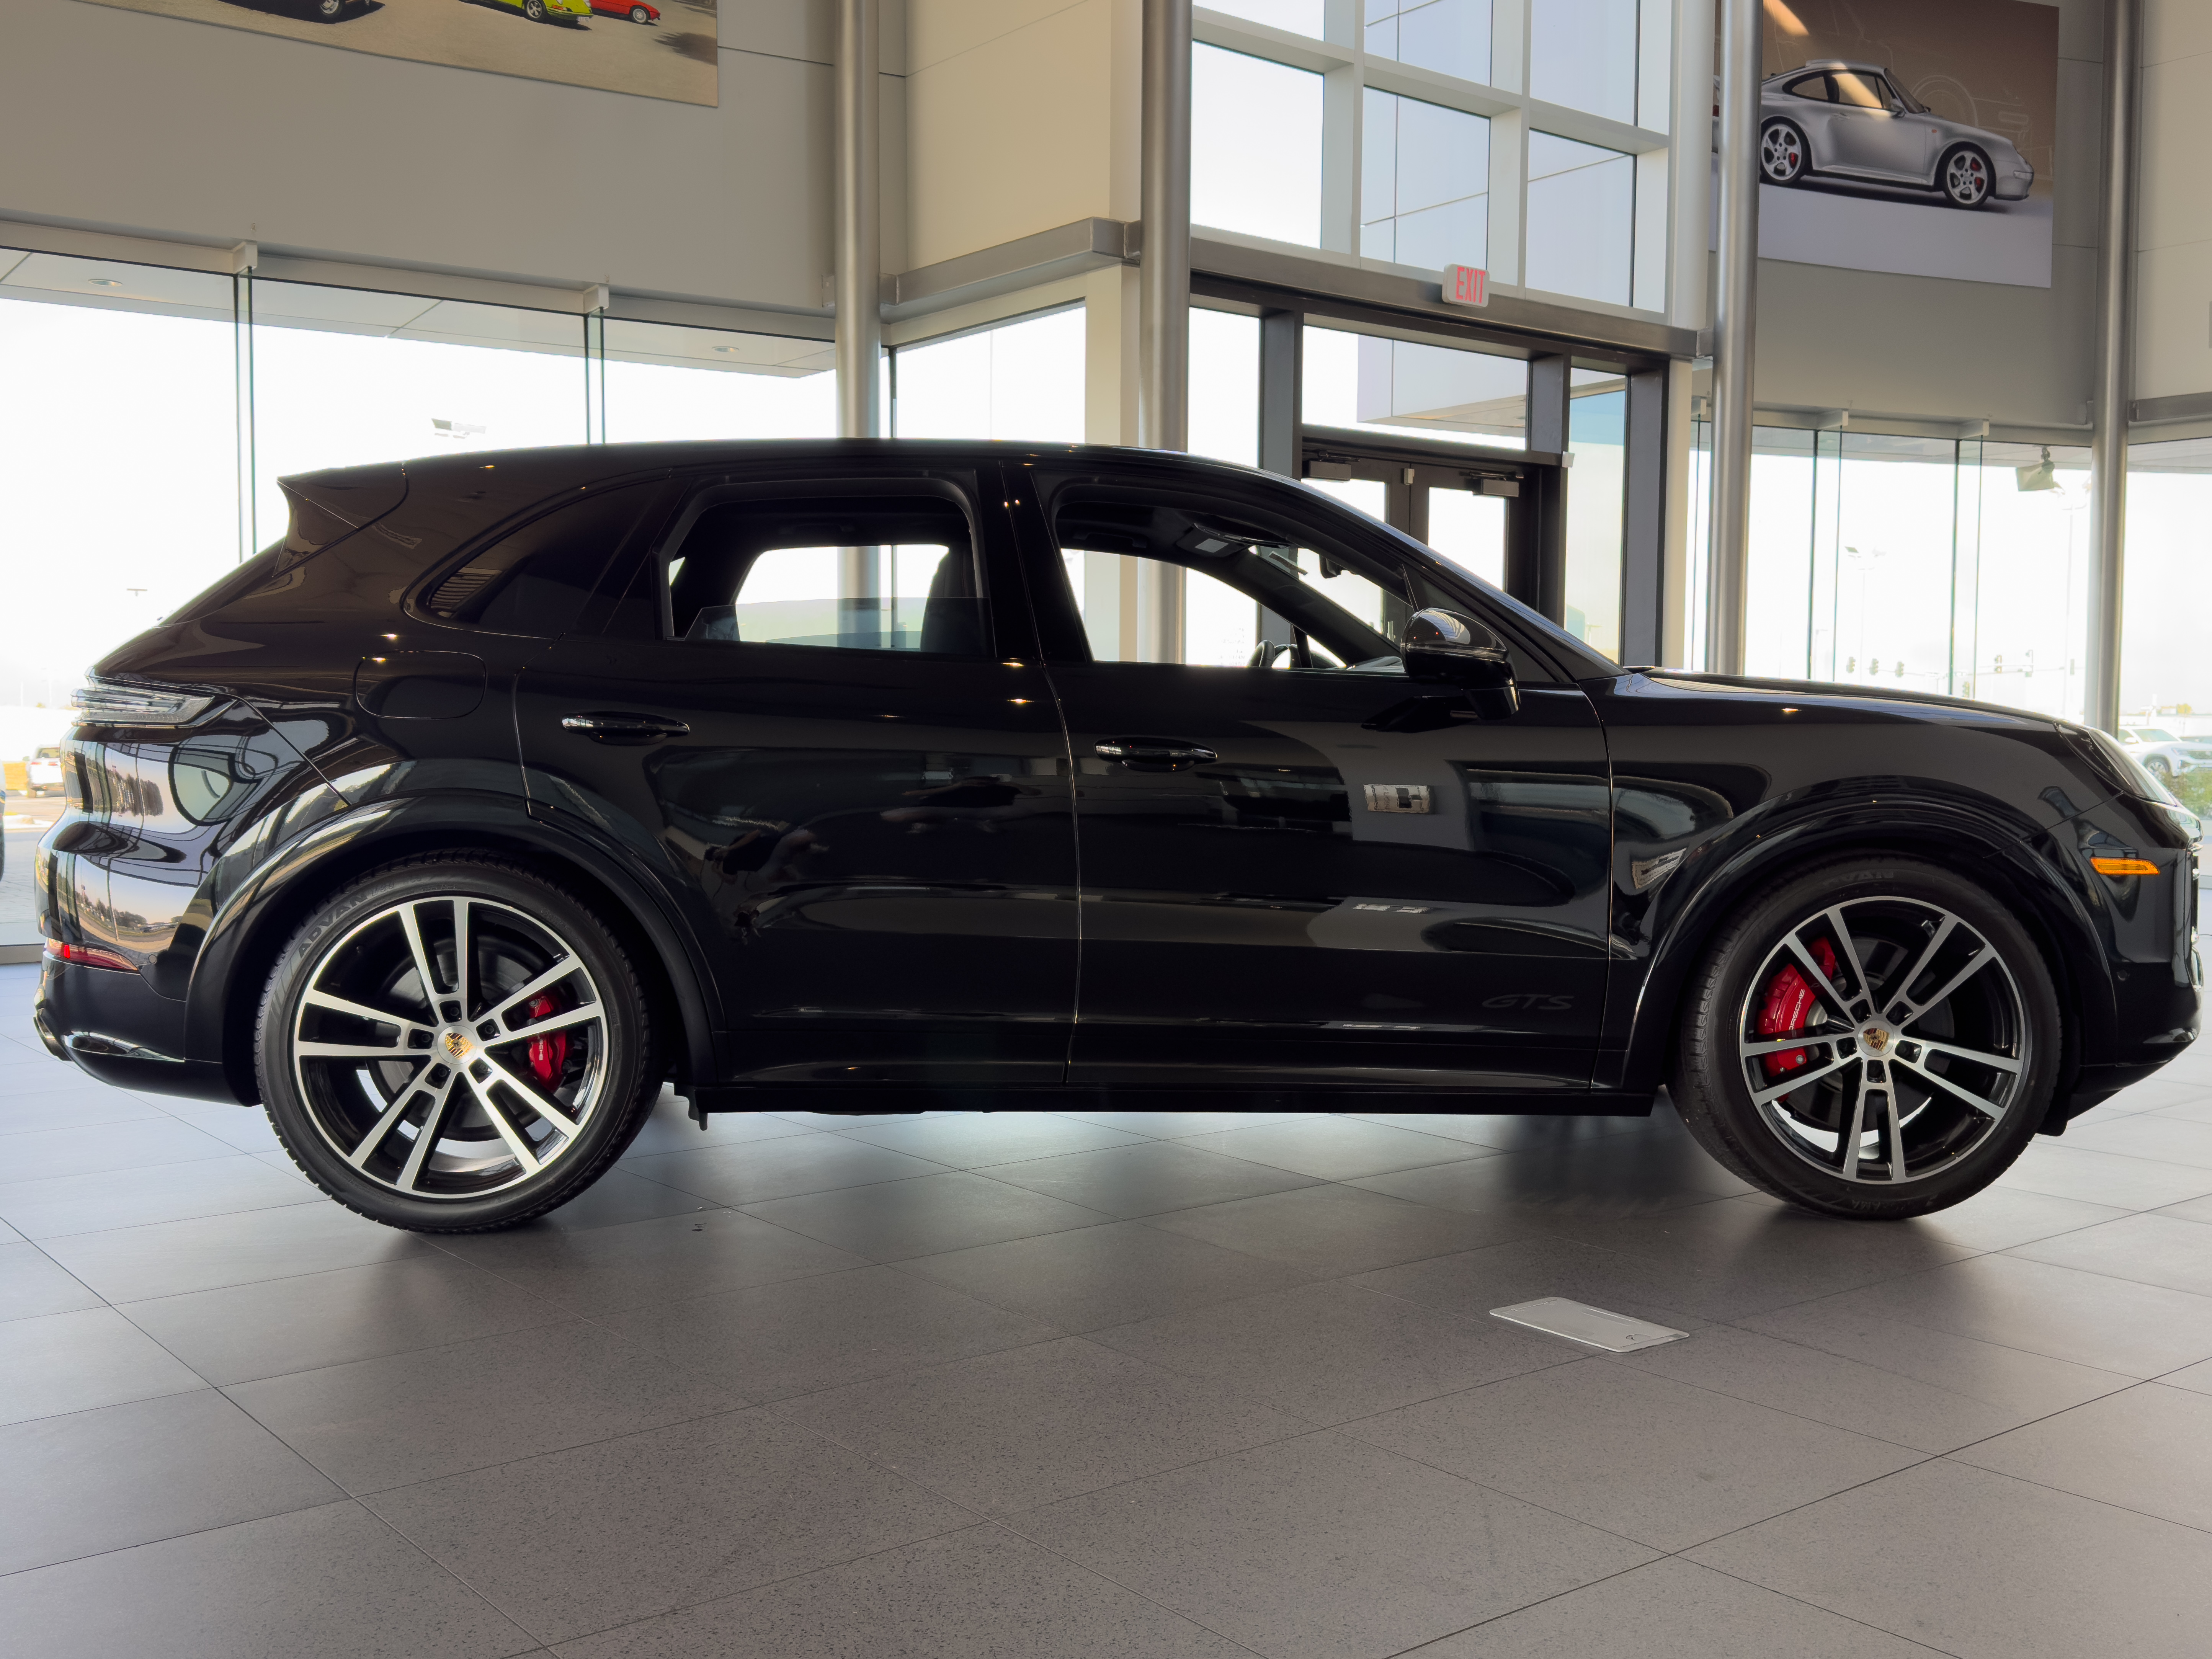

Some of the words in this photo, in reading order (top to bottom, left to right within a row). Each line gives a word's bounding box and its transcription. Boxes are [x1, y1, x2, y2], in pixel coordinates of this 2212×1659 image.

[1456, 266, 1486, 304] EXIT
[298, 894, 368, 958] ADVAN
[1482, 994, 1574, 1010] GTS
[1789, 989, 1805, 1030] ORSCHE
